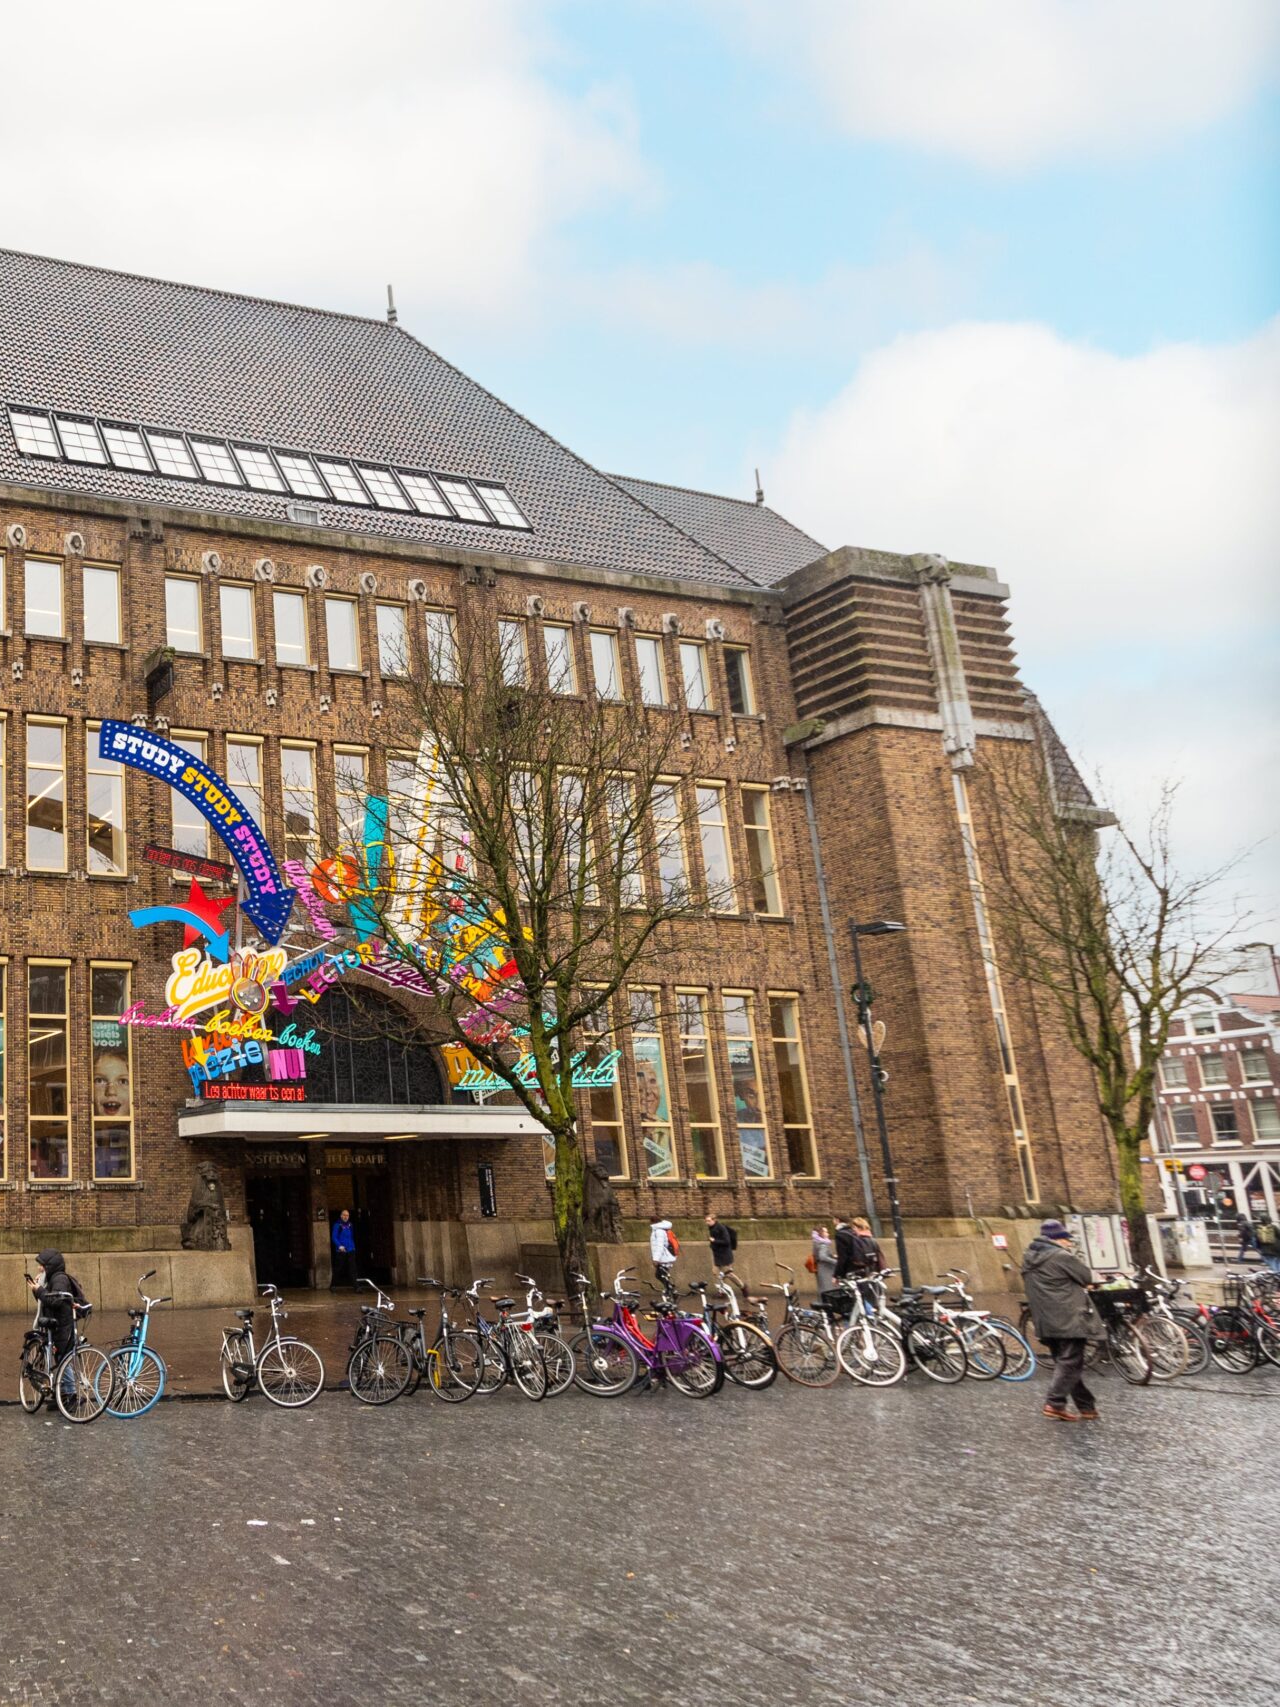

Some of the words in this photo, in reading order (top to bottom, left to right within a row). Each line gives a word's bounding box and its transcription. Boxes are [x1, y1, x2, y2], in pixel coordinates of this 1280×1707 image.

[112, 731, 186, 775] STUDY
[181, 766, 243, 827] STUDY
[233, 824, 276, 895] STUDY
[299, 941, 380, 1005] LECTORI
[93, 1030, 120, 1039] bieb
[94, 1039, 122, 1047] voor
[118, 1000, 197, 1031] boeken
[204, 1009, 273, 1042] boeken
[278, 1023, 321, 1056] boeken
[270, 1049, 307, 1080] NU!
